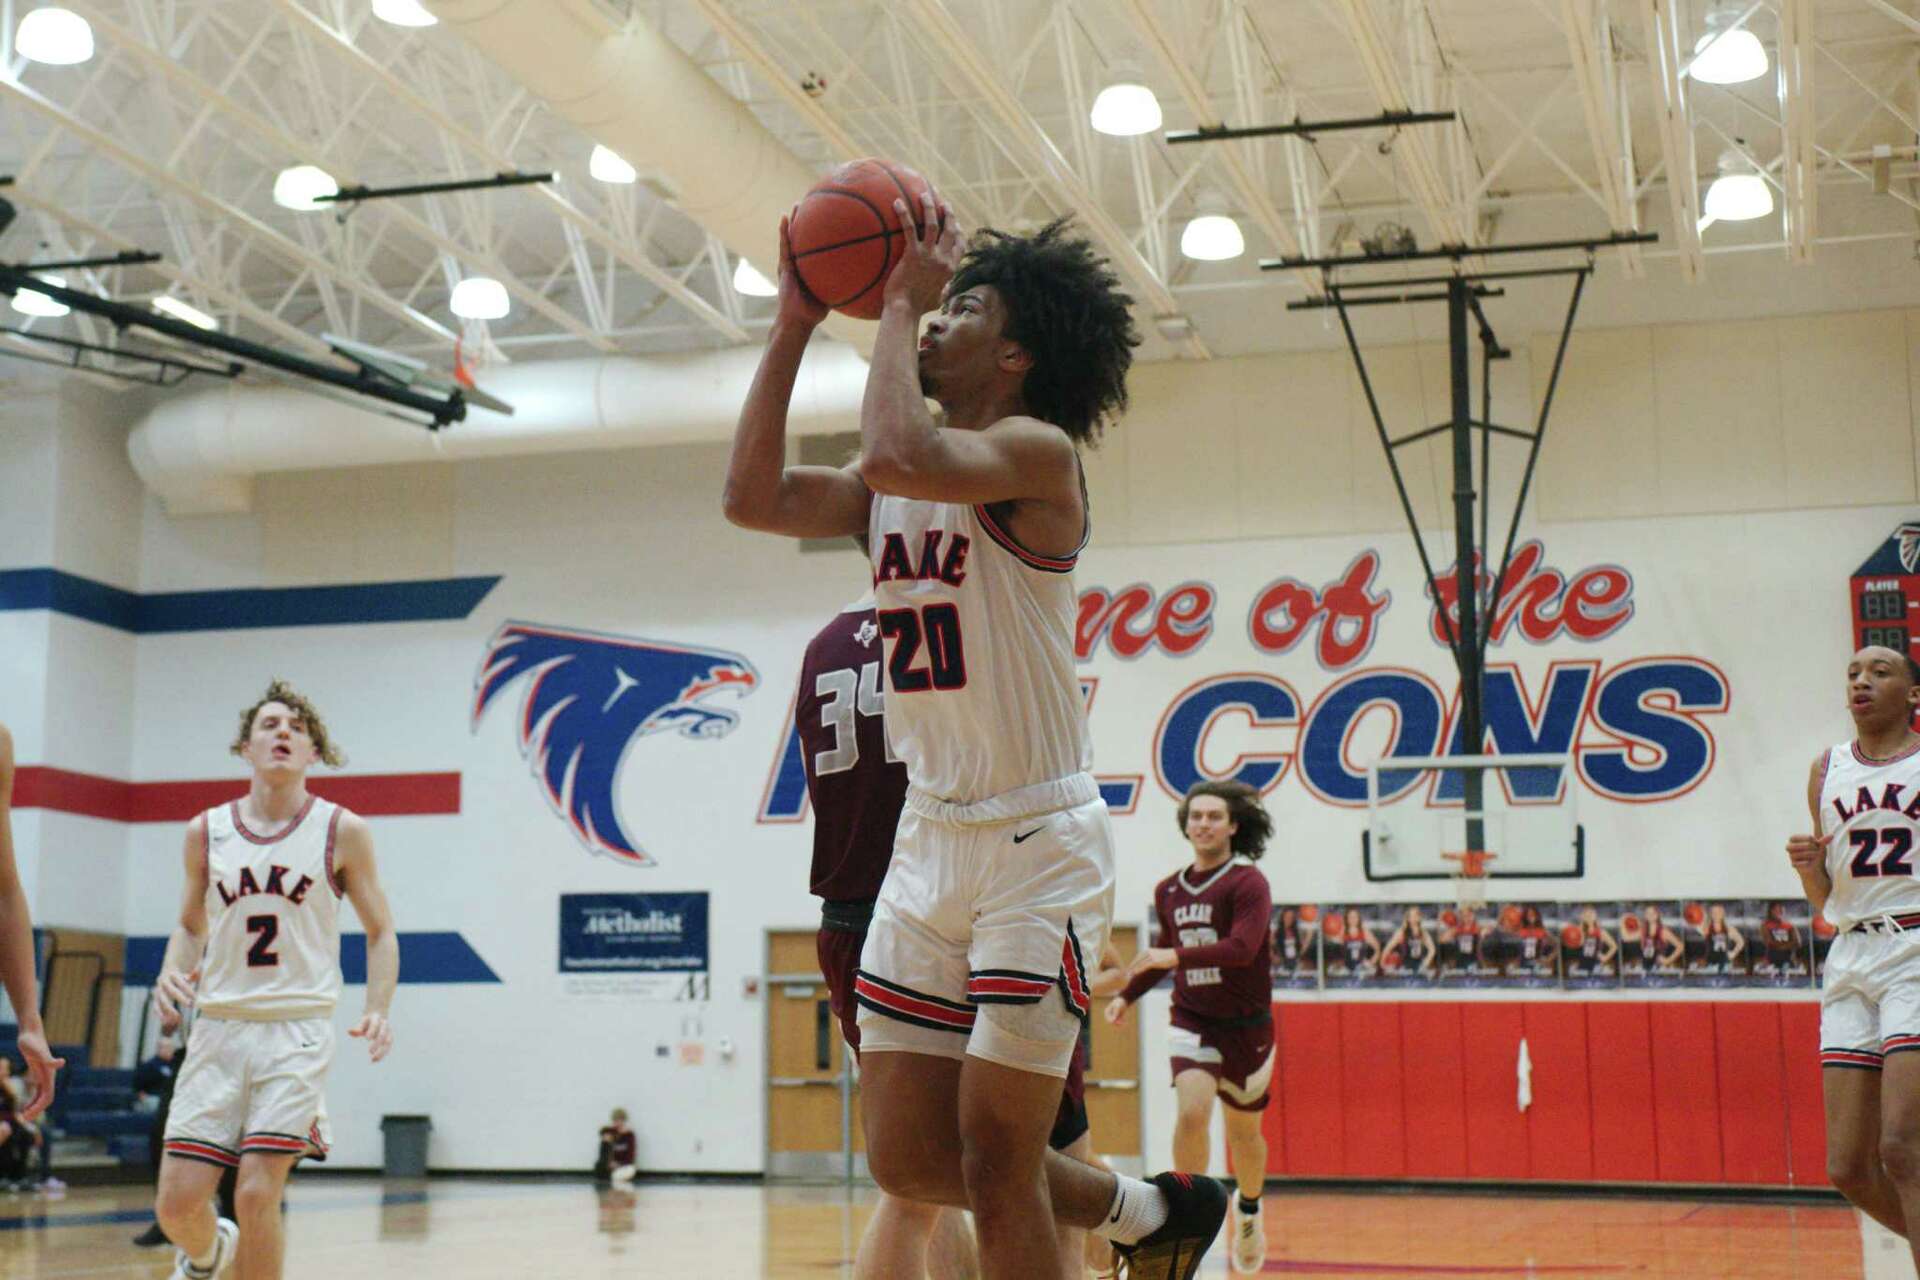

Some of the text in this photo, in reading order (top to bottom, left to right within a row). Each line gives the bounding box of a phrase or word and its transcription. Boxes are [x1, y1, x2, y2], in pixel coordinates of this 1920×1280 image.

[873, 530, 970, 588] AKE
[1425, 539, 1634, 648] the
[876, 601, 968, 693] 20
[1848, 826, 1913, 879] 22
[216, 864, 314, 908] LAKE
[246, 913, 279, 968] 2
